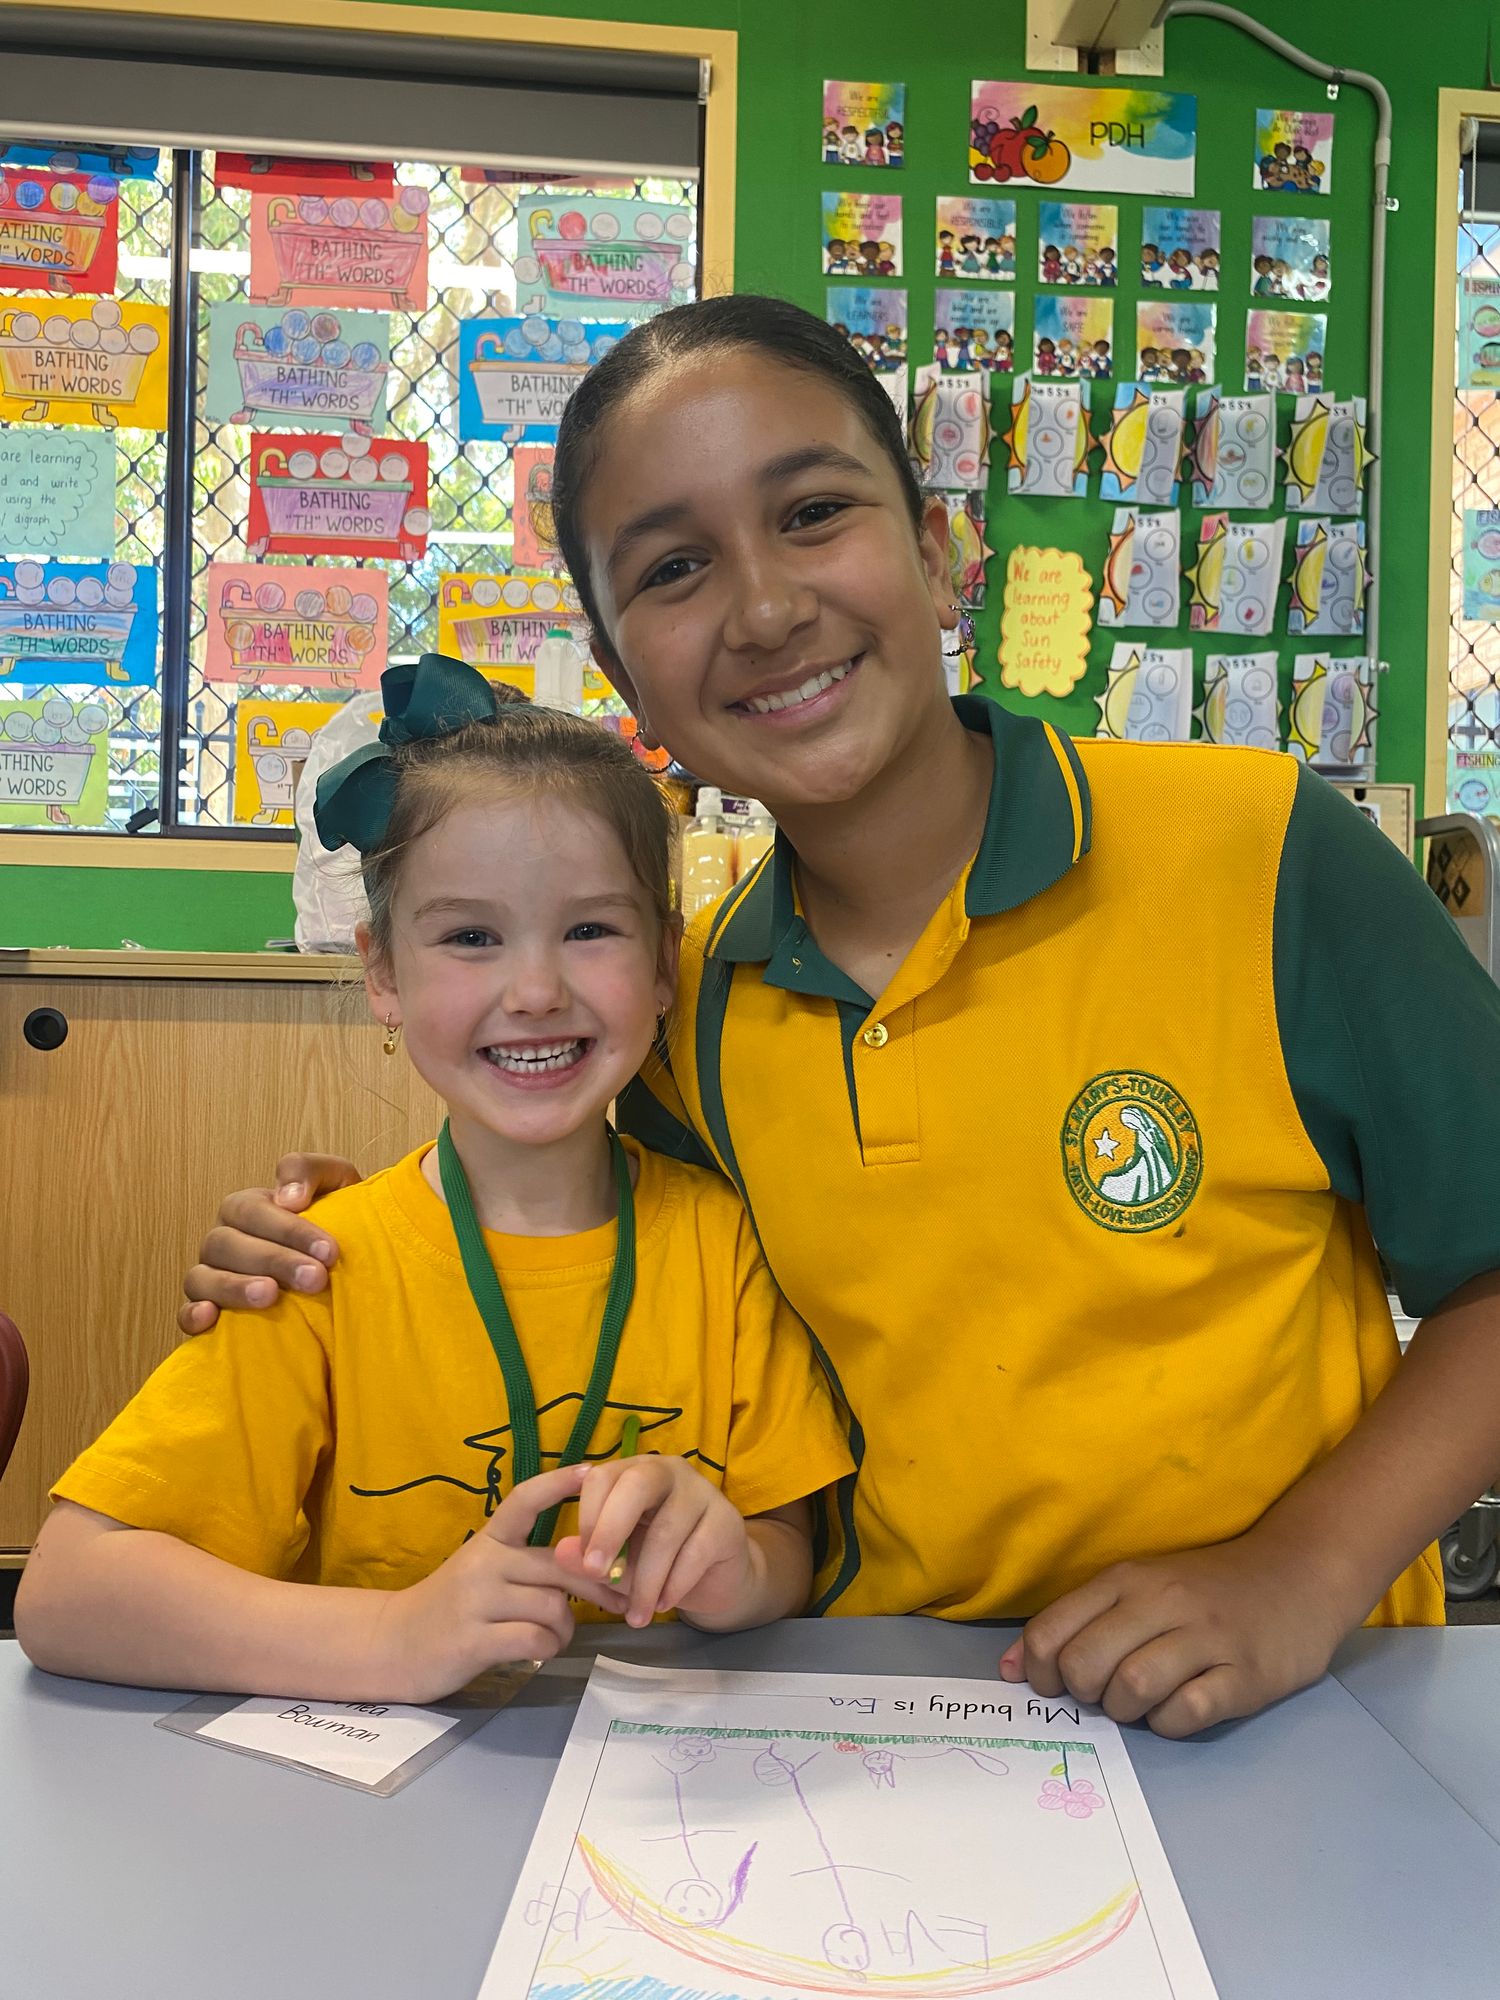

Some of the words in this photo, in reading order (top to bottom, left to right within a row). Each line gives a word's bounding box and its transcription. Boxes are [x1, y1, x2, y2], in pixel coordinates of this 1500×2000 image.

[1090, 120, 1145, 149] PDH
[15, 245, 75, 266] WORDS
[310, 239, 383, 260] BATHING
[573, 252, 644, 272] BATHING
[337, 266, 395, 285] WORDS
[600, 278, 656, 295] WORDS
[35, 350, 109, 371] BATHING
[21, 374, 57, 391] "TH"
[61, 377, 122, 396] WORDS
[276, 367, 348, 388] BATHING
[261, 388, 297, 404] "TH"
[302, 391, 360, 410] WORDS
[498, 398, 533, 416] "TH"
[1, 451, 21, 463] are
[30, 449, 82, 471] learning
[20, 475, 39, 487] and
[50, 477, 79, 489] write
[5, 495, 32, 510] using
[40, 494, 56, 505] the
[300, 491, 371, 511] BATHING
[15, 513, 50, 530] digraph
[285, 514, 321, 531] "TH"
[326, 516, 385, 534] WORDS
[1013, 563, 1030, 582] We
[1039, 570, 1063, 584] are
[1013, 587, 1070, 612] learning
[24, 612, 97, 633] BATHING
[1020, 611, 1060, 625] about
[263, 622, 335, 642] BATHING
[1022, 631, 1050, 648] Sun
[9, 635, 47, 653] "TH"
[51, 637, 110, 655] WORDS
[477, 642, 513, 659] "TH"
[291, 647, 348, 664] WORDS
[1015, 653, 1062, 676] Safety
[0, 753, 54, 773] THING
[7, 777, 67, 798] WORDS
[828, 1697, 876, 1714] Eva
[894, 1700, 915, 1715] is
[929, 1695, 1012, 1721] buddy
[1028, 1699, 1080, 1725] My
[276, 1704, 380, 1743] Bowman
